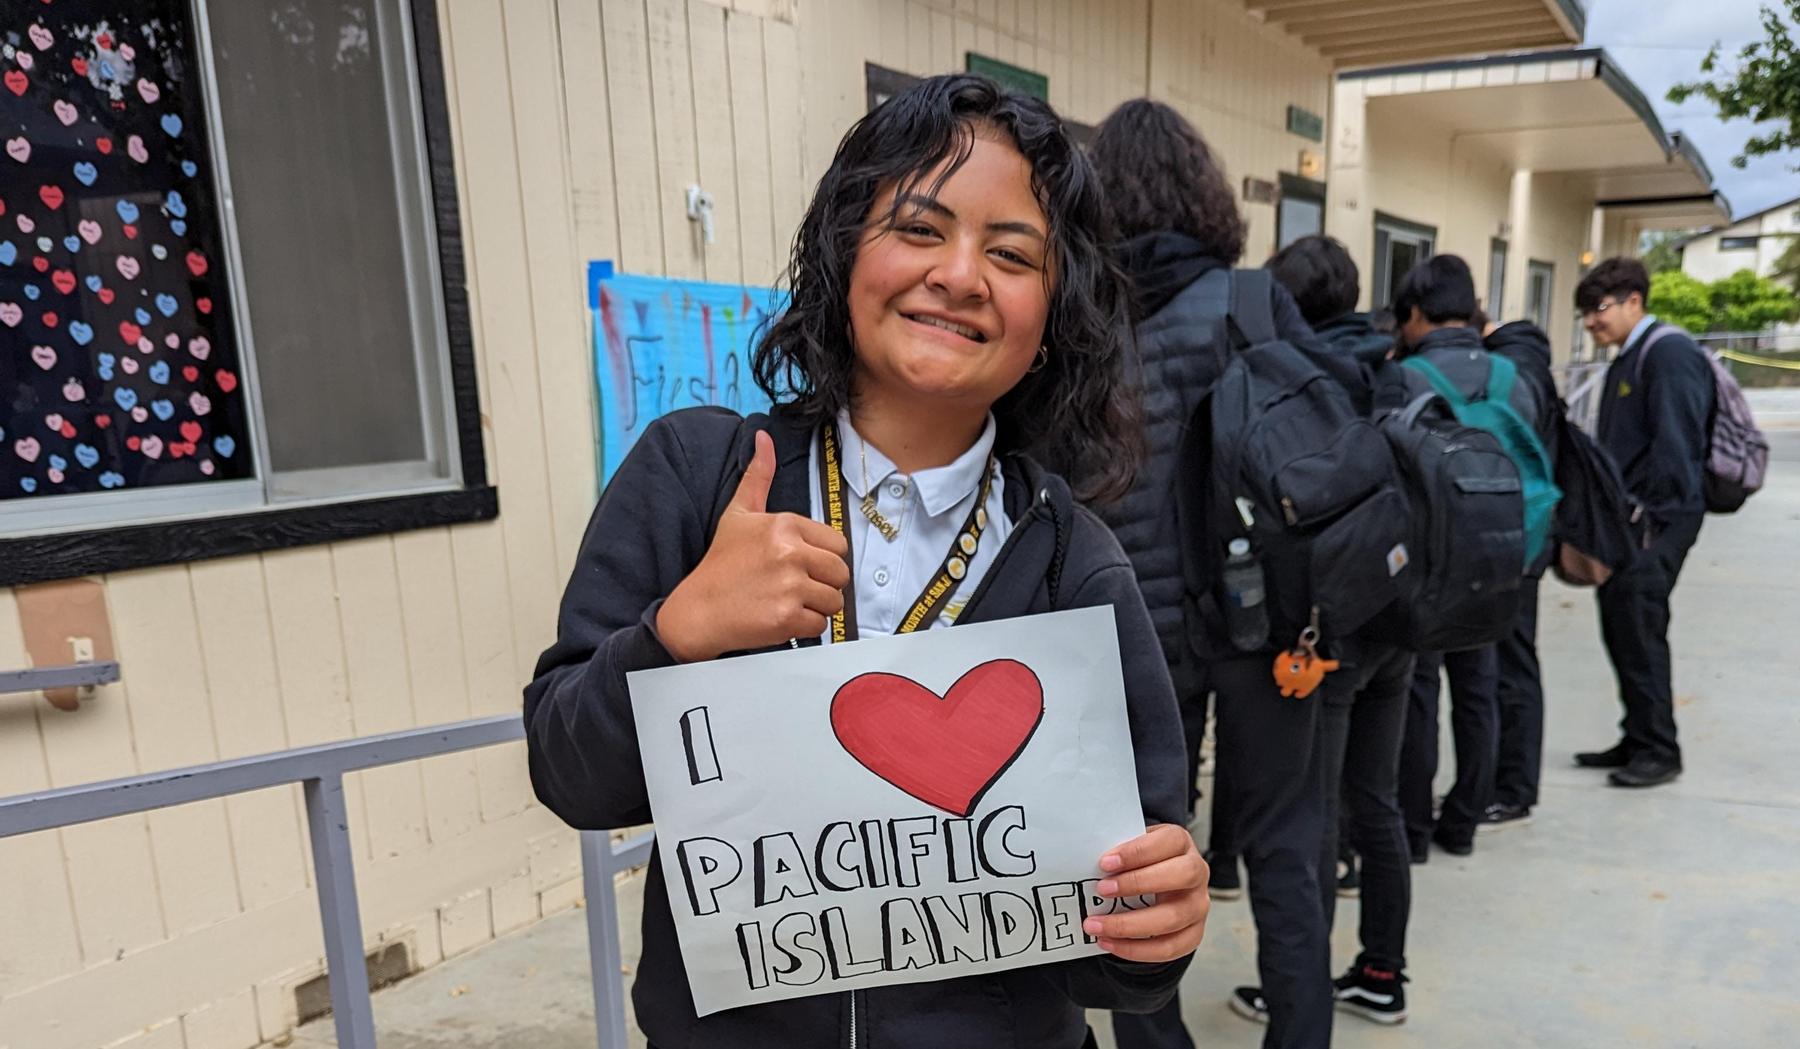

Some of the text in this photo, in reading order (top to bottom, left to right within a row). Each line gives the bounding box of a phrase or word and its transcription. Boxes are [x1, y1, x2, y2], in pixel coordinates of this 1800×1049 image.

[828, 460, 840, 492] MONTH
[829, 492, 839, 502] at
[830, 501, 842, 519] SAN
[924, 595, 936, 608] at
[929, 579, 946, 599] SAN
[833, 608, 846, 641] PACA
[900, 602, 928, 633] MONTH
[679, 706, 722, 785] I
[676, 805, 1037, 916] PACIFIC
[736, 878, 1152, 990] ISLANDER
